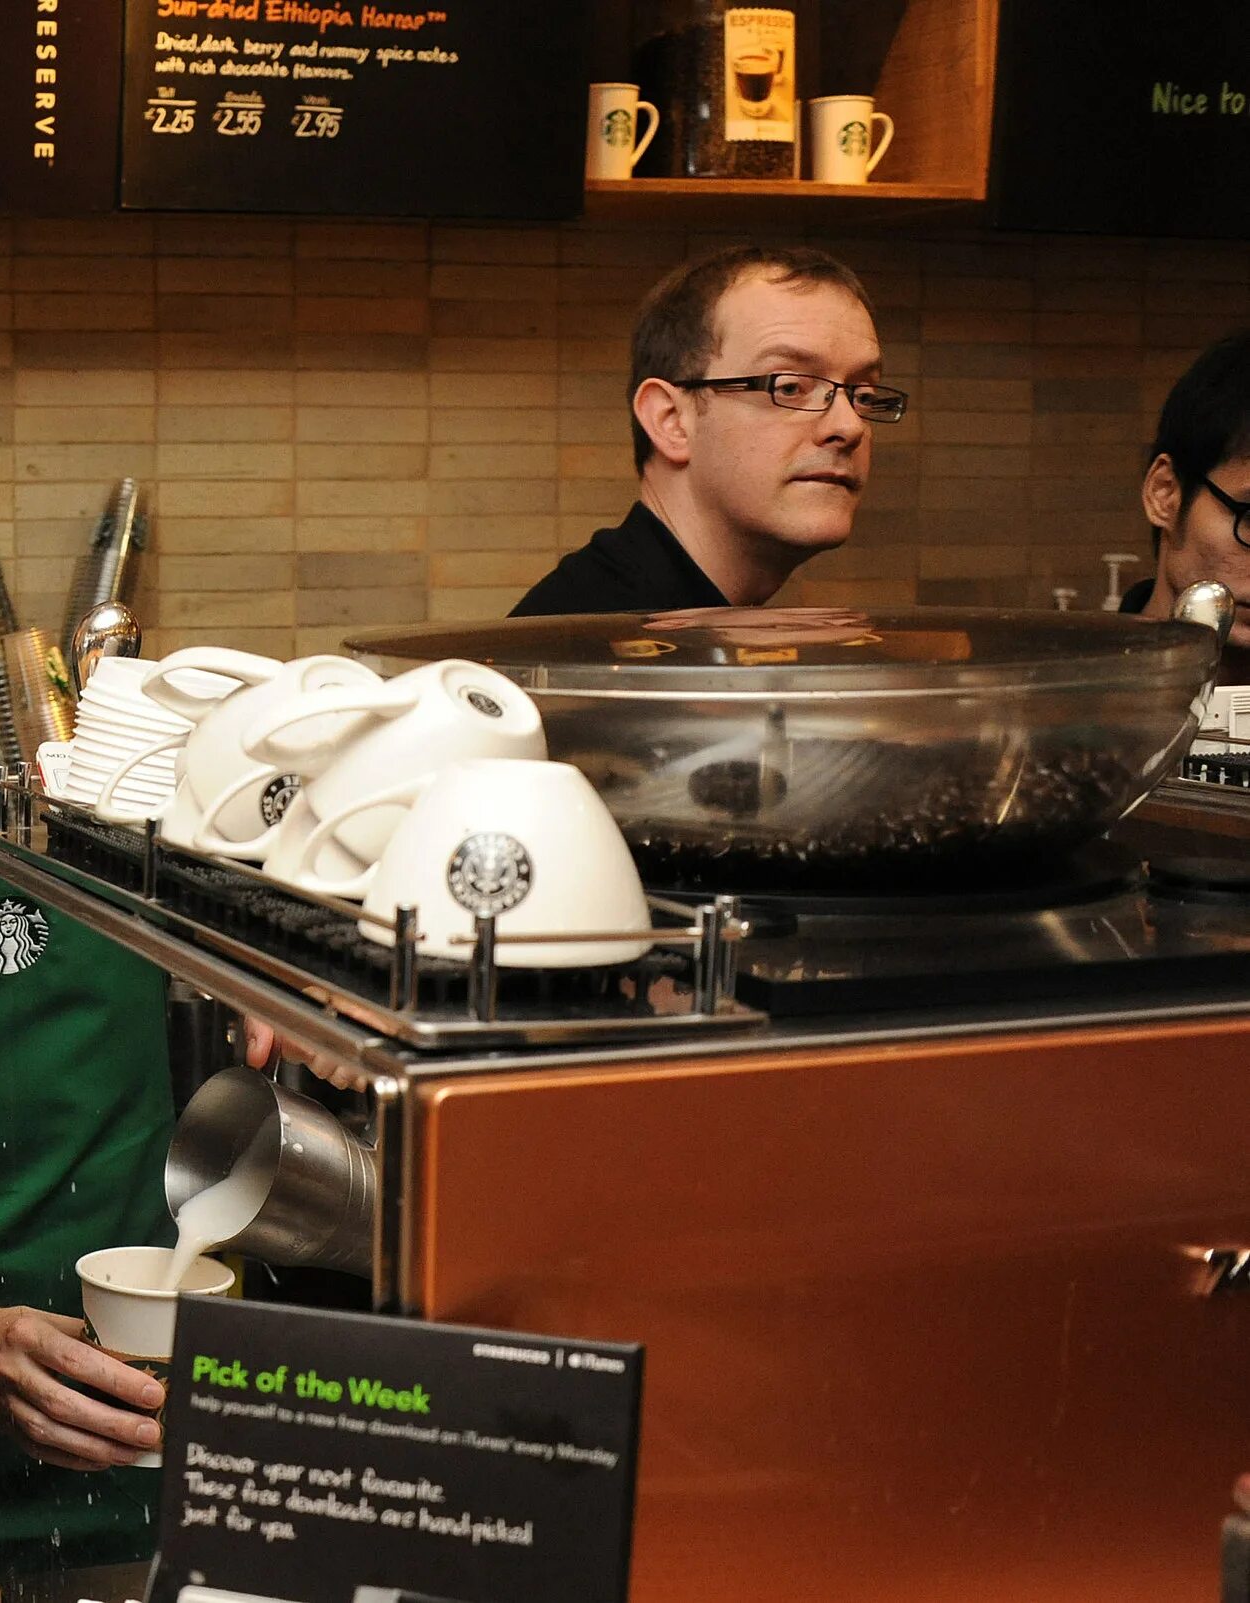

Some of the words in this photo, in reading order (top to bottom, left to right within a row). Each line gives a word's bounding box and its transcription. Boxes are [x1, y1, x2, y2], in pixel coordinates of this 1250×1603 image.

[157, 0, 259, 22] Sun-dried
[265, 0, 353, 33] Ethiopia
[154, 56, 185, 73] with
[188, 58, 217, 75] rich
[219, 59, 289, 77] chocolate
[243, 38, 284, 60] berry
[289, 40, 318, 57] and
[319, 46, 370, 64] rummy
[376, 44, 415, 68] spice
[417, 45, 459, 63] notes
[34, 0, 58, 158] RESERVE
[1152, 81, 1208, 114] Nice
[1220, 81, 1246, 114] to
[192, 1355, 248, 1390] Pick
[255, 1365, 288, 1394] of
[296, 1369, 343, 1402] the
[348, 1377, 430, 1414] Week
[187, 1442, 259, 1473] Discover
[263, 1463, 305, 1485] your
[308, 1467, 355, 1489] next
[181, 1500, 219, 1527] just
[226, 1505, 257, 1532] for
[183, 1471, 236, 1500] These
[242, 1478, 282, 1506] free
[285, 1487, 377, 1524] downloads
[380, 1508, 416, 1529] are
